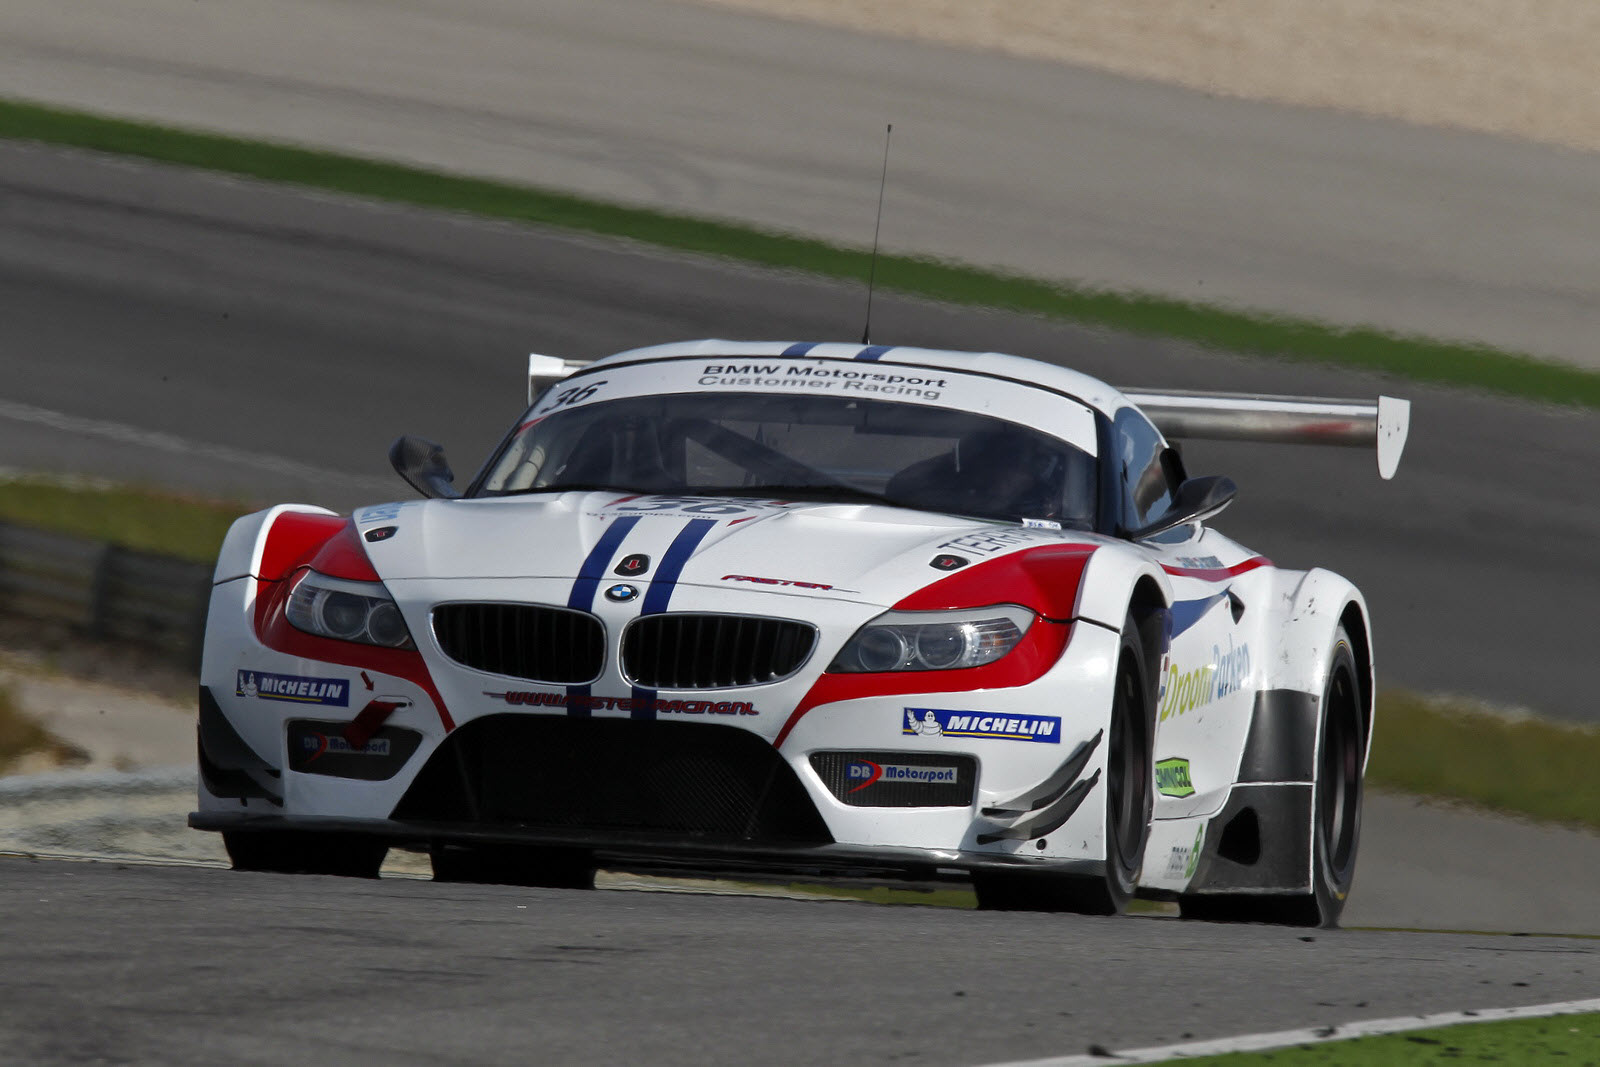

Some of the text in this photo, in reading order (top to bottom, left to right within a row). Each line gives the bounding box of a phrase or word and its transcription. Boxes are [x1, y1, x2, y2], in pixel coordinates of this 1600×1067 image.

[697, 374, 942, 400] Customer Racing
[702, 364, 948, 389] BMW Motorsport
[540, 380, 609, 414] 36
[260, 677, 343, 699] MICHELIN
[946, 715, 1056, 736] MICHELIN
[849, 764, 954, 783] DB Motorsport
